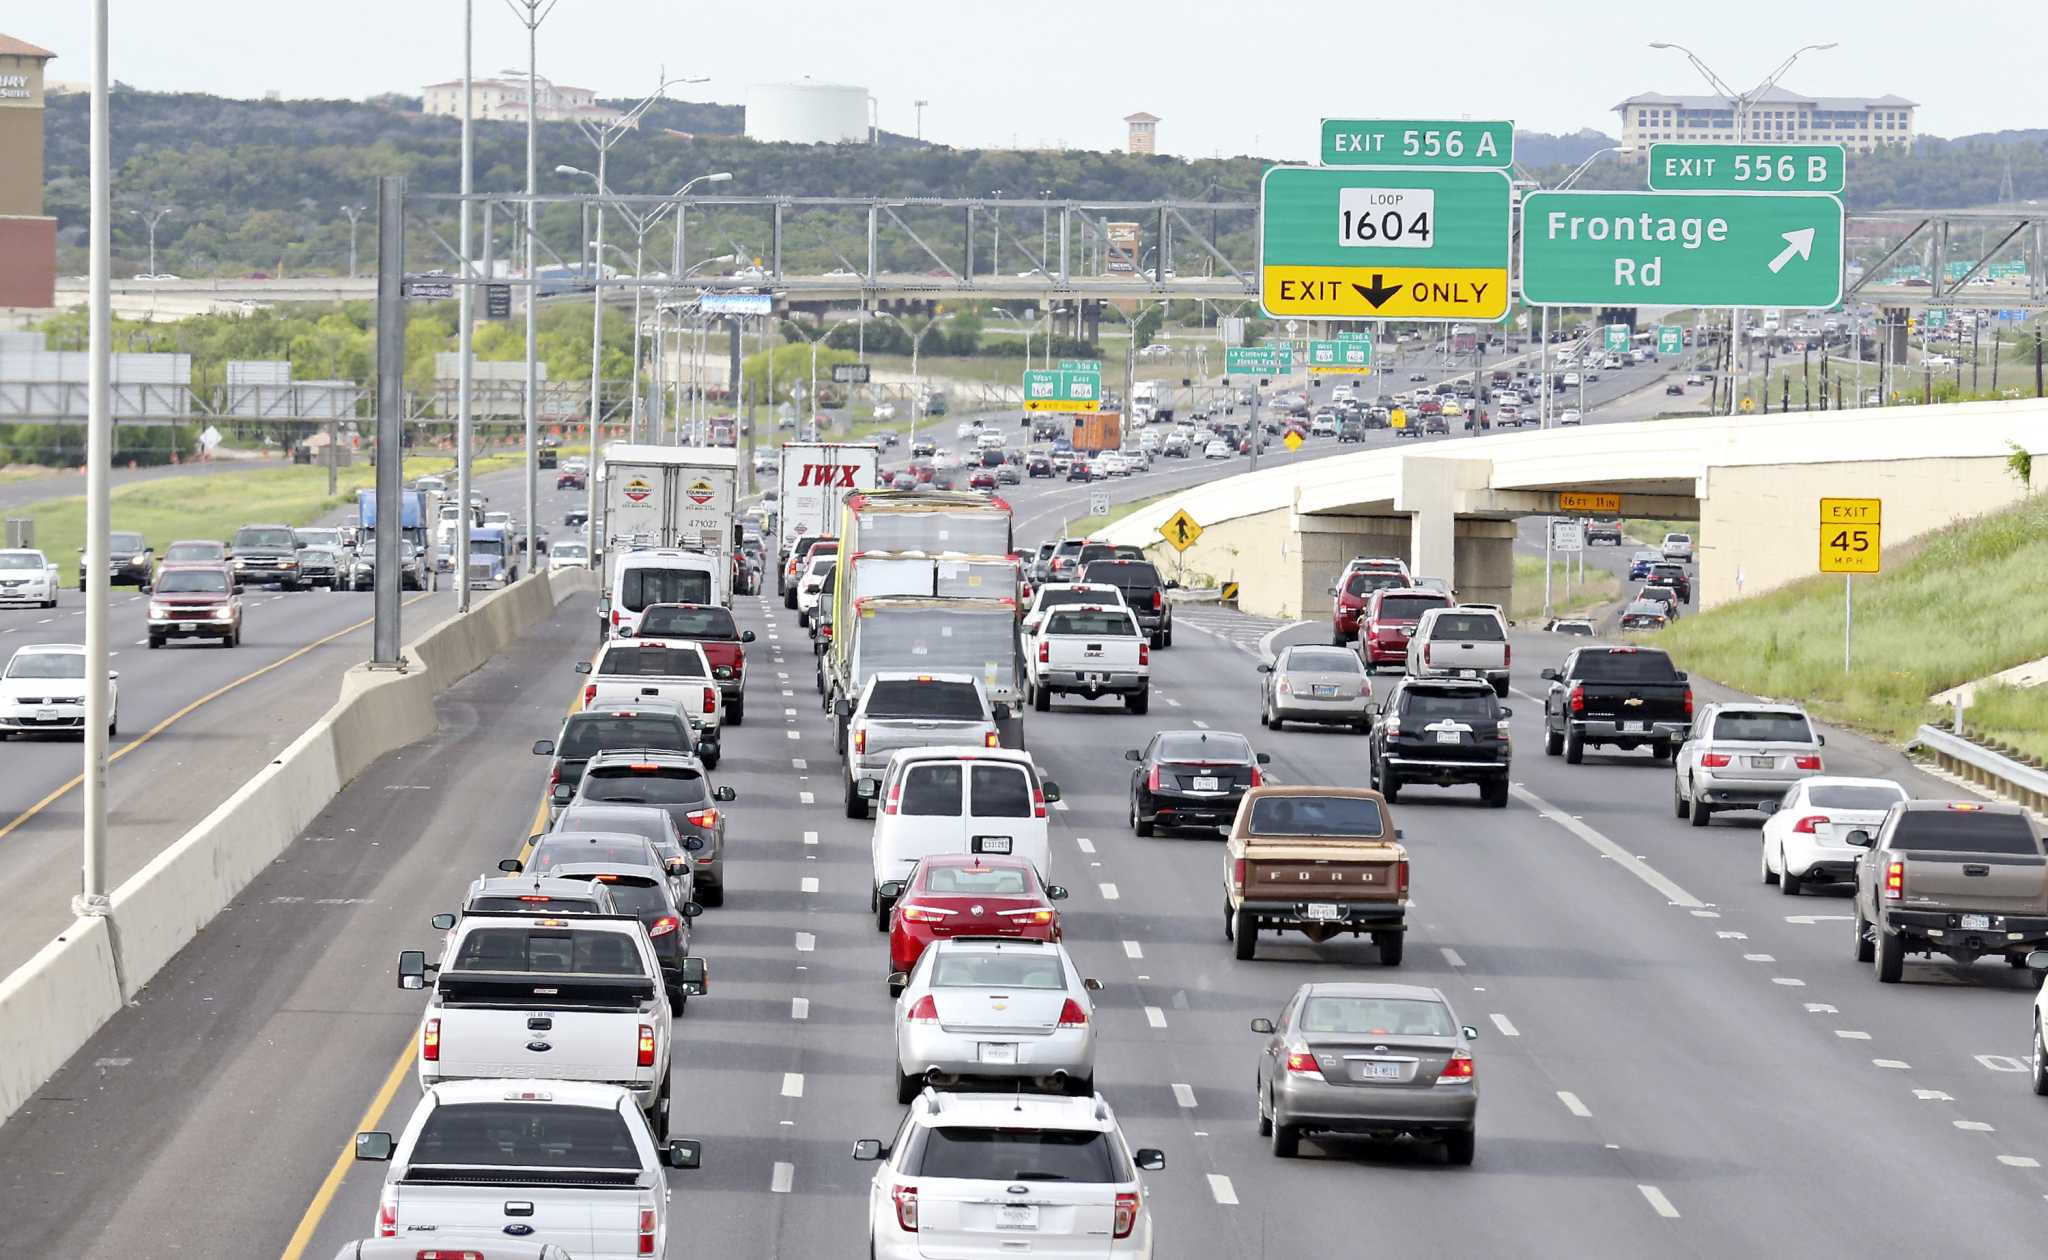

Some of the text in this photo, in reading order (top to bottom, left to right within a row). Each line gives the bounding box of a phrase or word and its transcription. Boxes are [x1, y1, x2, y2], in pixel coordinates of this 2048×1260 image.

[1335, 131, 1498, 157] EXIT 556 A
[1666, 155, 1828, 182] EXIT 556 B
[1370, 194, 1404, 206] LOOP
[1343, 210, 1430, 242] 1604
[1548, 212, 1729, 249] Frontage
[1615, 256, 1662, 287] Rd
[1281, 280, 1489, 303] EXIT ONLY
[798, 464, 861, 487] IWX
[1563, 497, 1575, 506] 16
[1833, 506, 1869, 517] EXIT
[1830, 531, 1869, 552] 45
